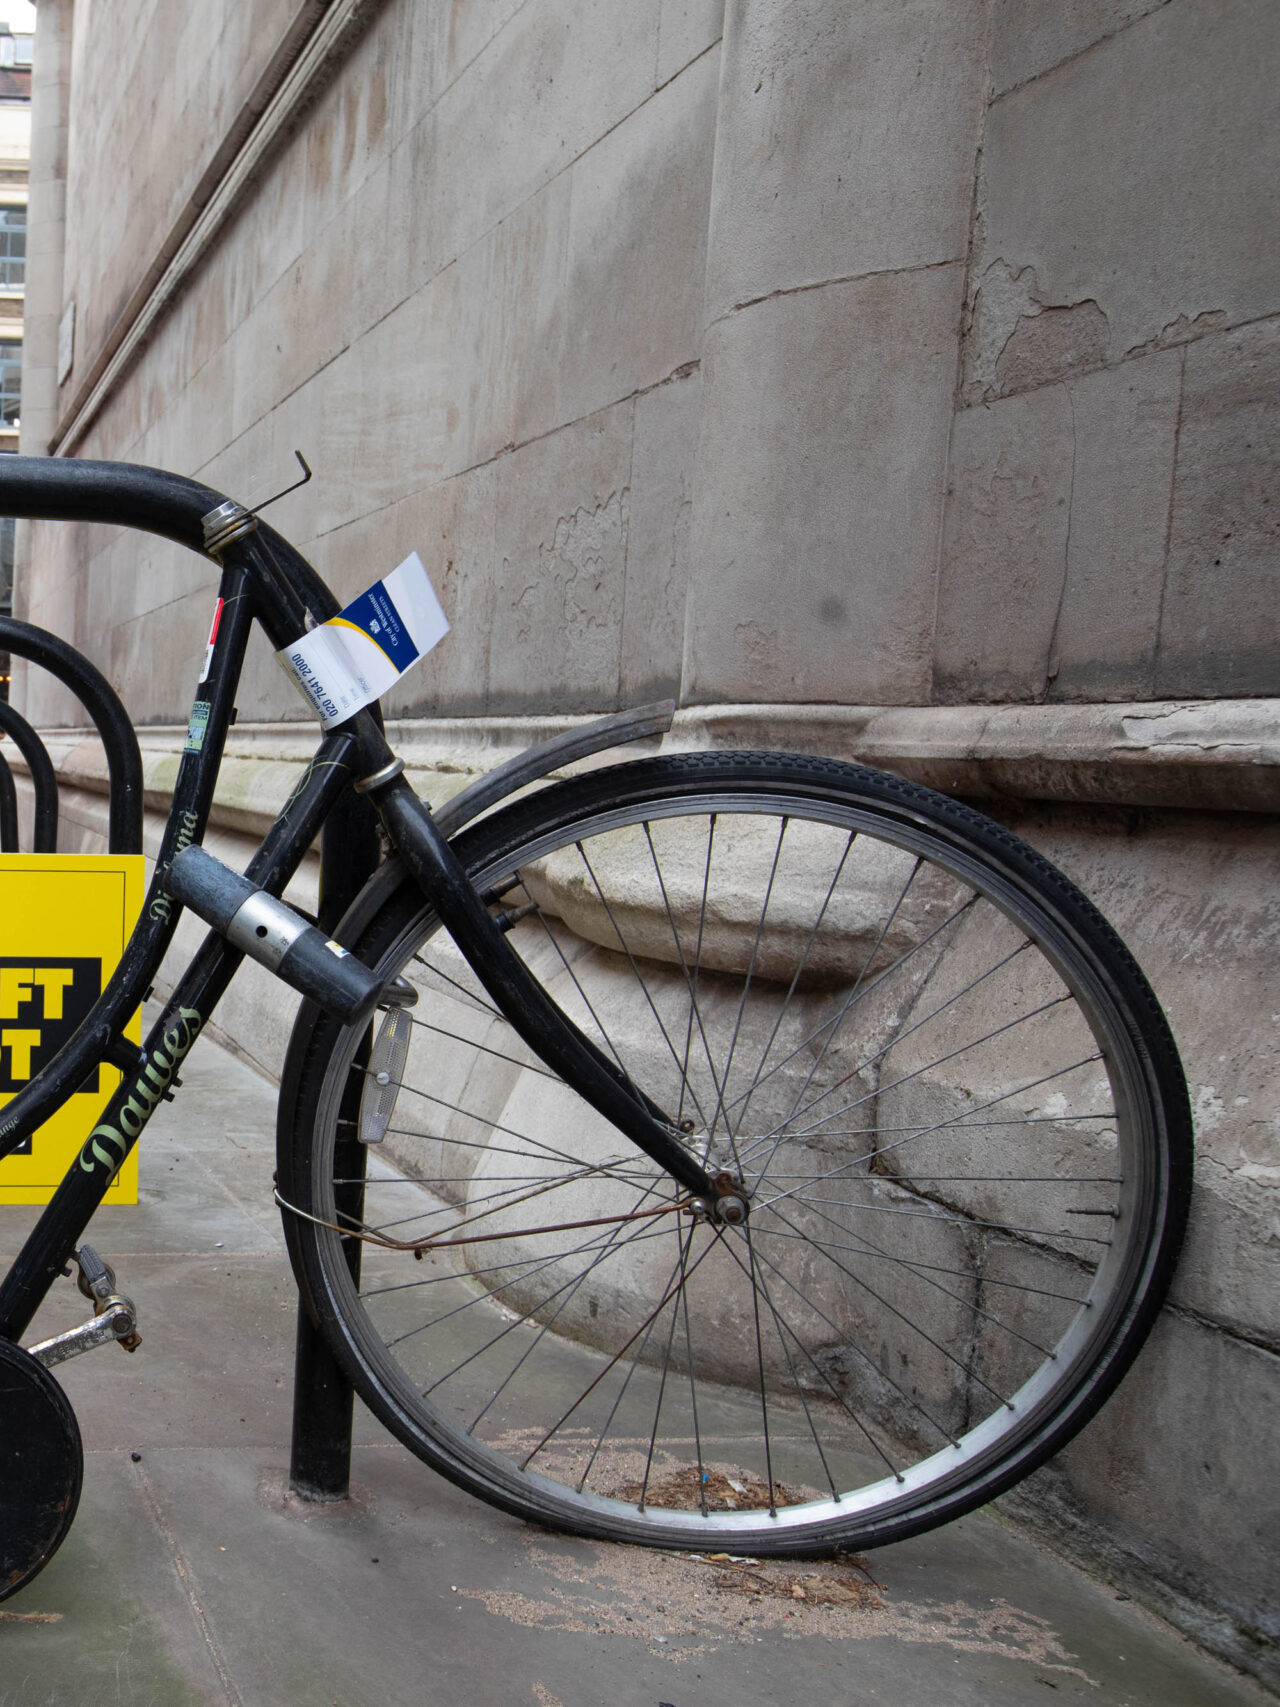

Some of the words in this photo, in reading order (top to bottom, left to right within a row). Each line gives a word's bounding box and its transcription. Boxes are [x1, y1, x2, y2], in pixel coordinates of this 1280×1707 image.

[368, 593, 388, 629] Westminster
[291, 653, 312, 677] 2000
[300, 681, 321, 710] enquiries
[307, 677, 327, 700] 7641
[319, 710, 328, 722] For
[322, 699, 339, 717] 020
[79, 1006, 202, 1186] Dawes
